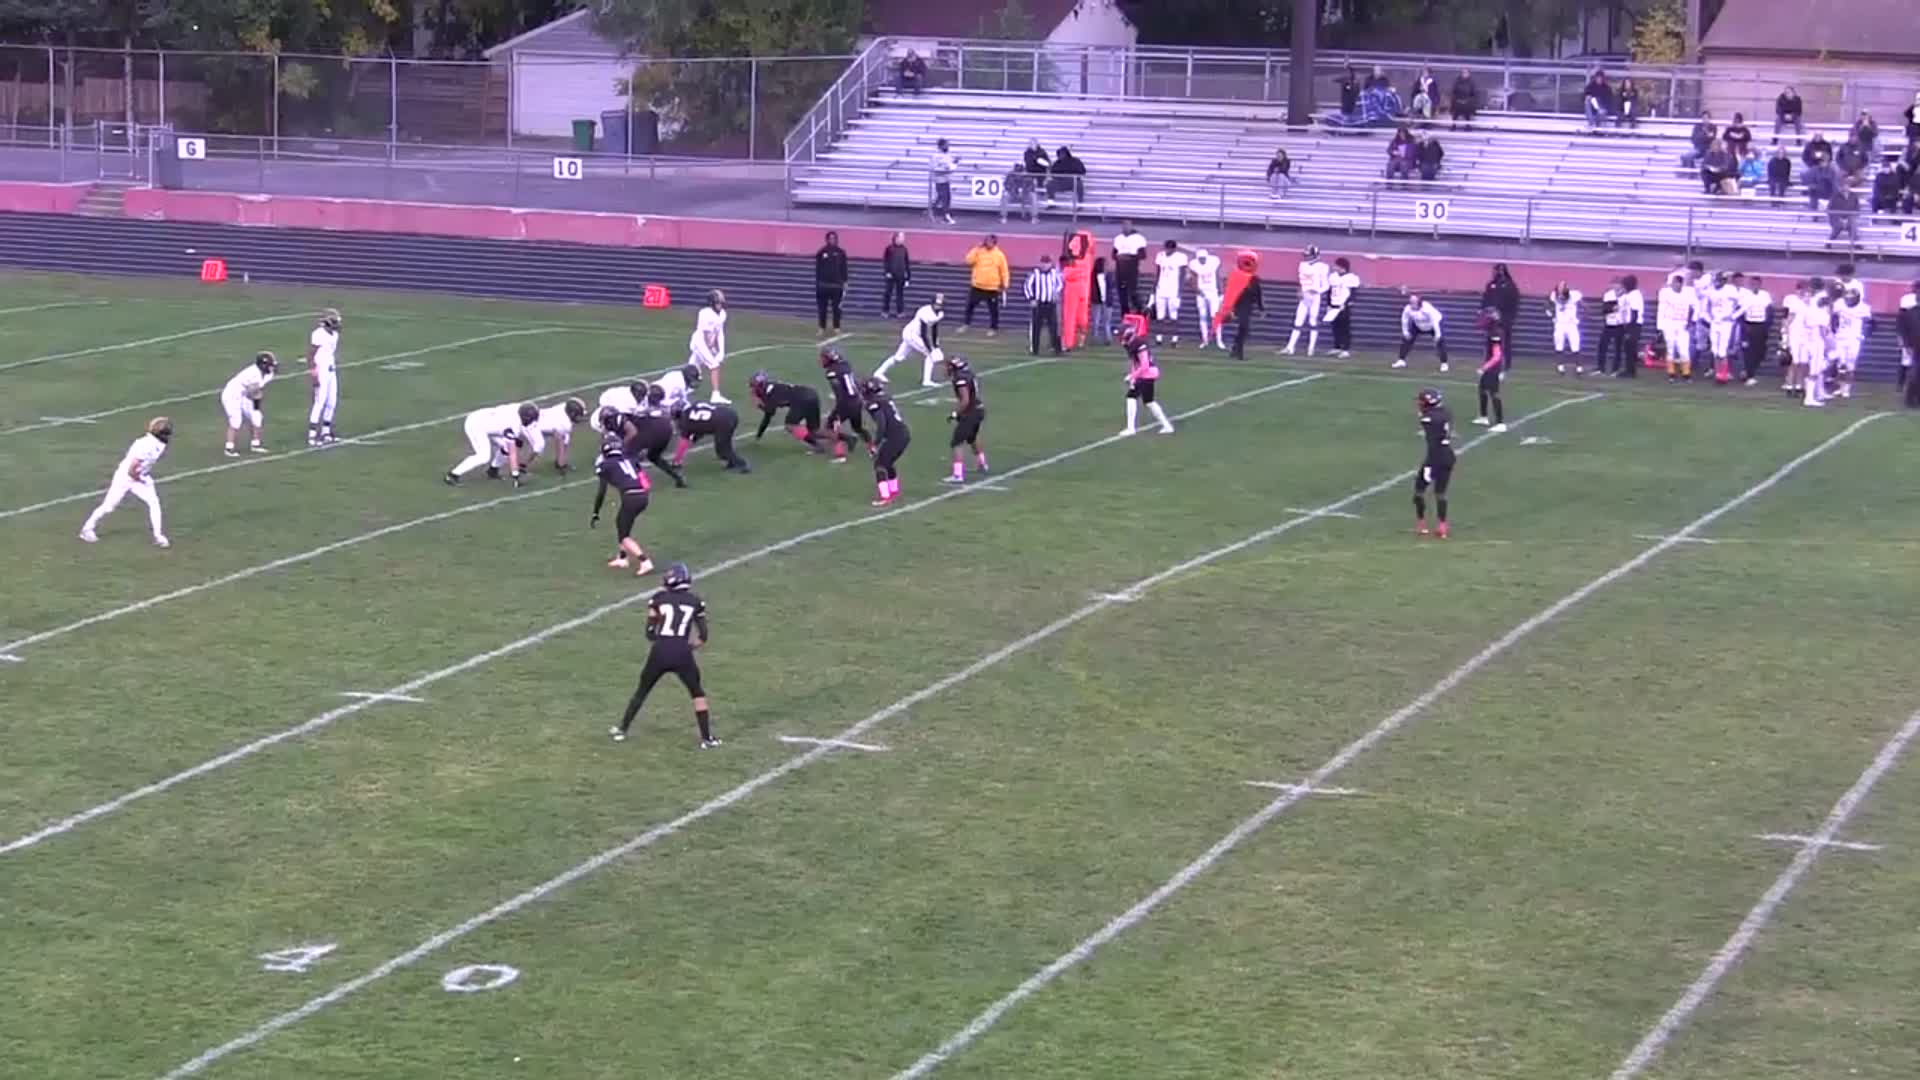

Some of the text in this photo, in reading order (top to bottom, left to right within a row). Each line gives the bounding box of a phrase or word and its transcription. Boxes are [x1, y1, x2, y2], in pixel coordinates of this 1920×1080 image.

[186, 141, 197, 156] G
[558, 160, 578, 176] 10
[975, 179, 1000, 196] 20
[1419, 203, 1445, 219] 30
